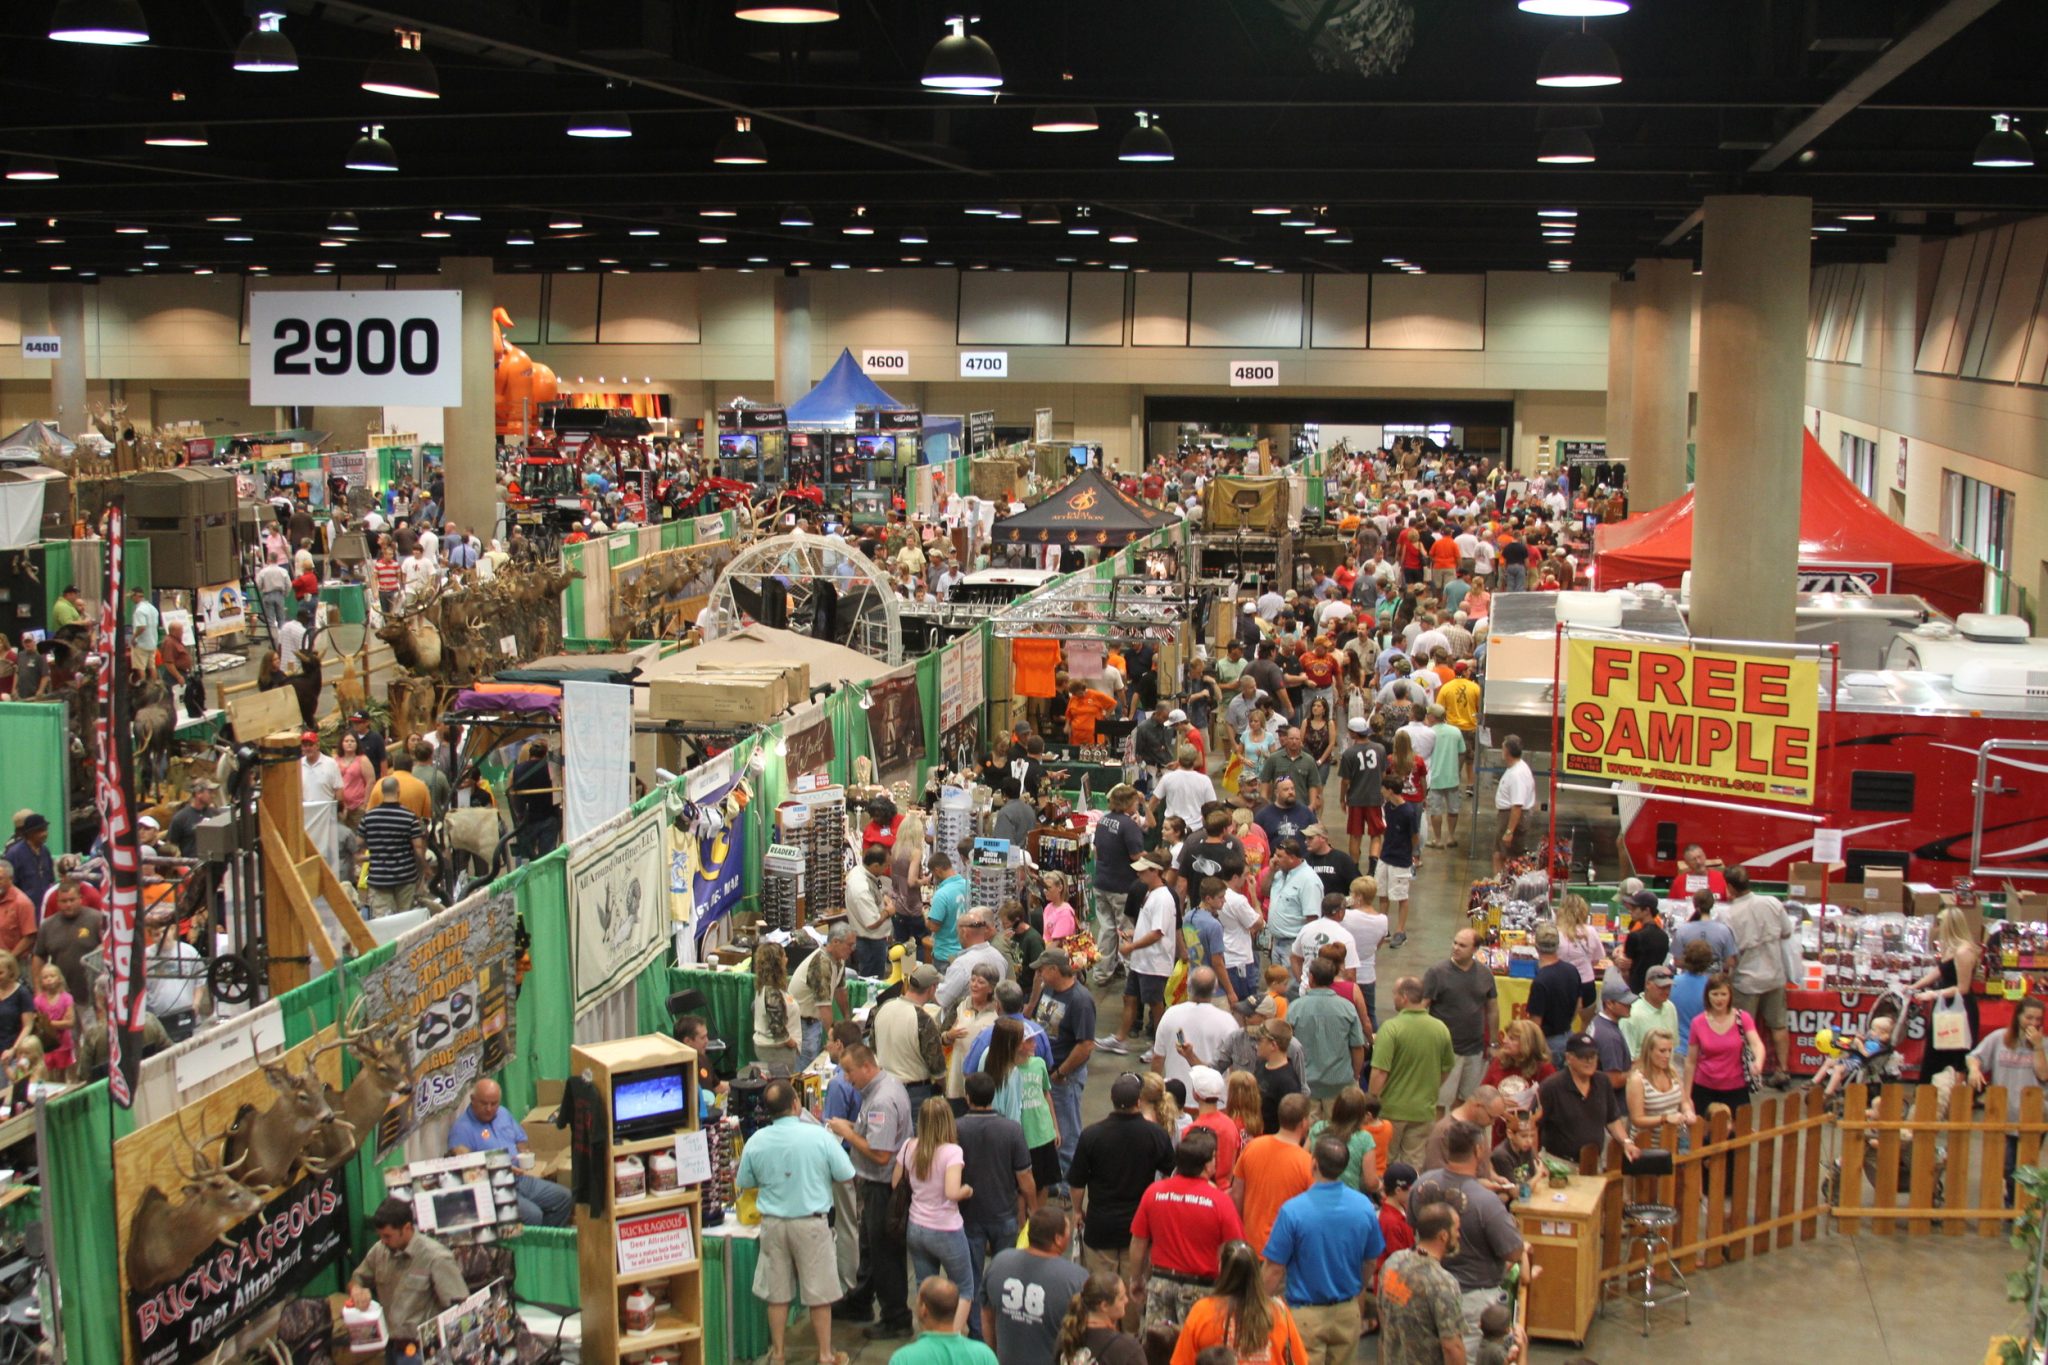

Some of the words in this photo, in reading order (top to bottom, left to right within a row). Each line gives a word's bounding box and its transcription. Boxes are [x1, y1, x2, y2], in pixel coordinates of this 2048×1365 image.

[25, 343, 59, 352] 4400
[273, 318, 440, 375] 2900
[867, 356, 903, 368] 4600
[966, 358, 1002, 370] 4700
[1235, 367, 1273, 379] 4800
[1591, 646, 1790, 717] FREE
[1569, 702, 1810, 780] SAMPLE
[1356, 749, 1378, 771] 13
[1567, 761, 1602, 772] ONLINE
[1569, 755, 1600, 764] ORDER
[1606, 762, 1766, 792] WWW.JERKYPETE.COM
[770, 846, 796, 857] READERS
[409, 918, 470, 972] STRENGTH
[417, 959, 441, 990] FOR
[1787, 1009, 1836, 1034] ACK
[1840, 1012, 1926, 1039] LIS
[1800, 1053, 1823, 1065] Feed
[1155, 1191, 1169, 1201] Feed
[1170, 1192, 1184, 1202] Your
[1185, 1193, 1199, 1204] Wild
[620, 1216, 682, 1237] BUCKRAGEOUS
[630, 1240, 646, 1249] Deer
[649, 1233, 680, 1245] Attractant
[136, 1178, 336, 1343] BUCKRAGEOUS
[189, 1301, 230, 1345] Deer
[231, 1241, 303, 1316] Attractant
[1001, 1277, 1046, 1316] 38
